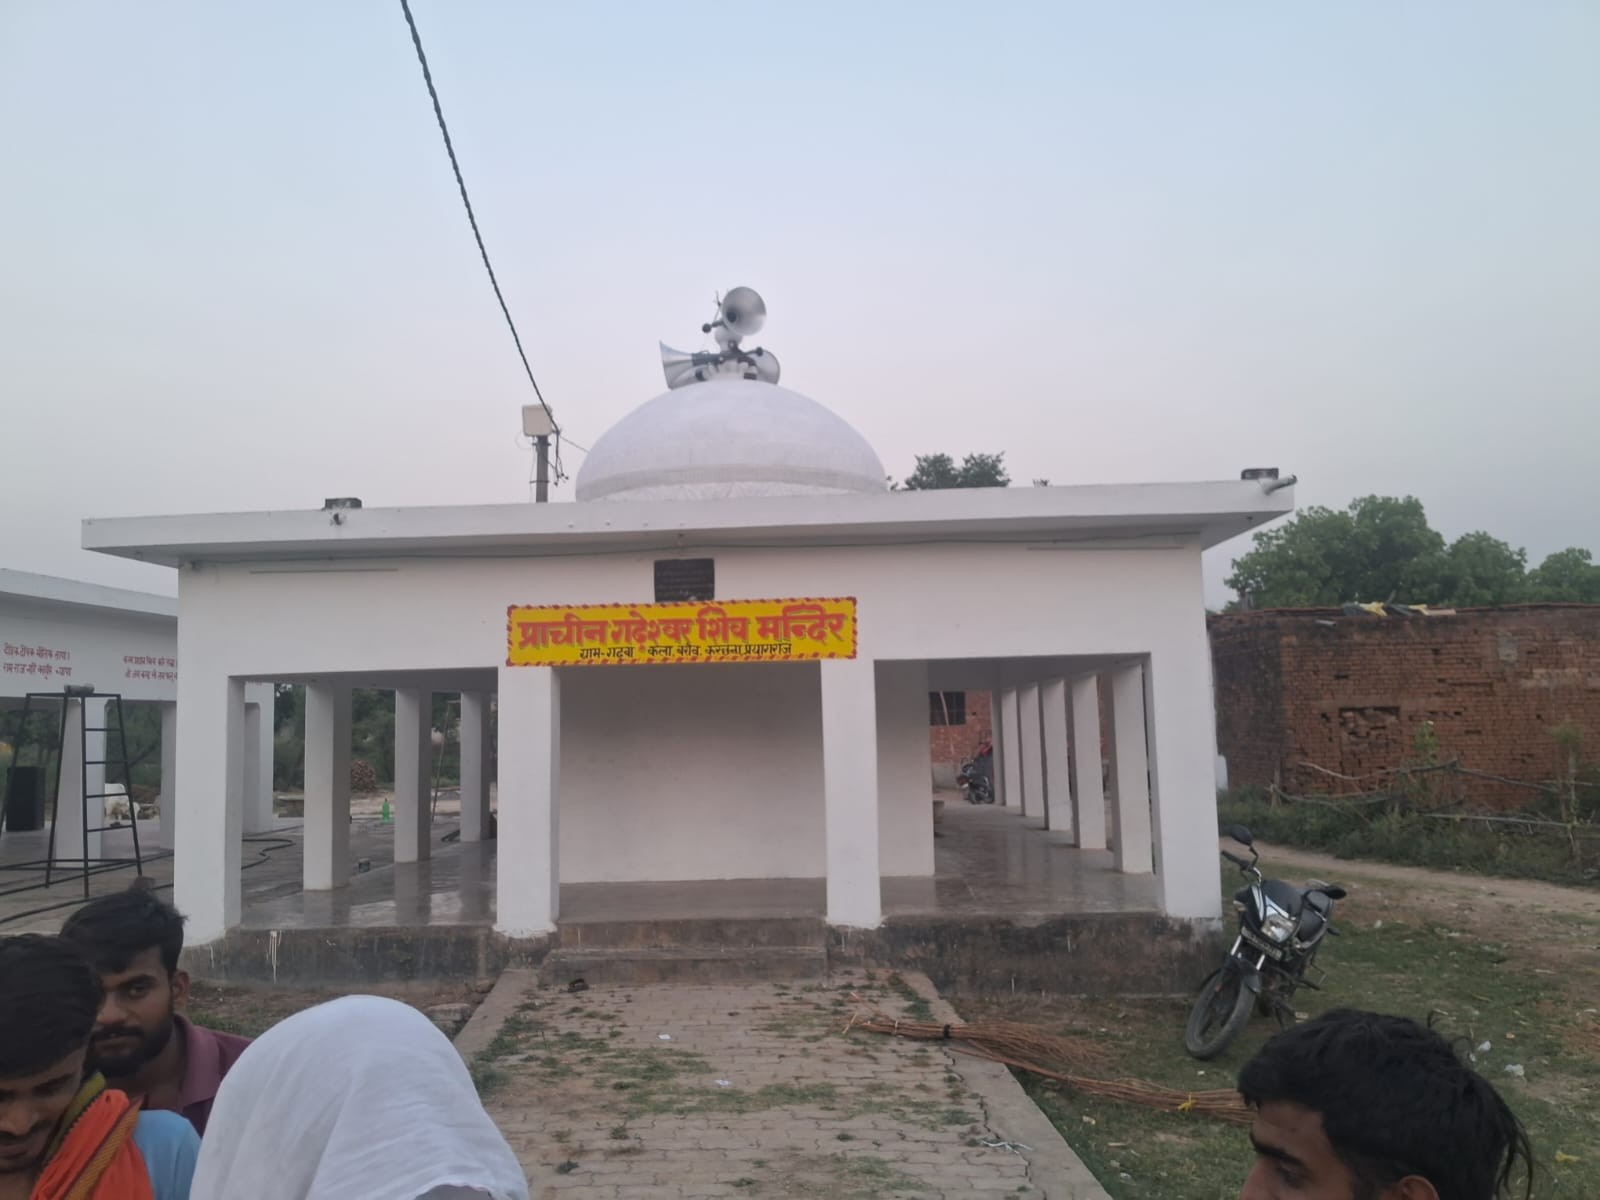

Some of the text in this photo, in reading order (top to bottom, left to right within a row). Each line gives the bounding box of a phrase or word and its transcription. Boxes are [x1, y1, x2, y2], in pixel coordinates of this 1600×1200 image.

[517, 611, 608, 649] प्राचीन
[695, 604, 750, 644] शिव
[755, 603, 847, 643] मन्दिर
